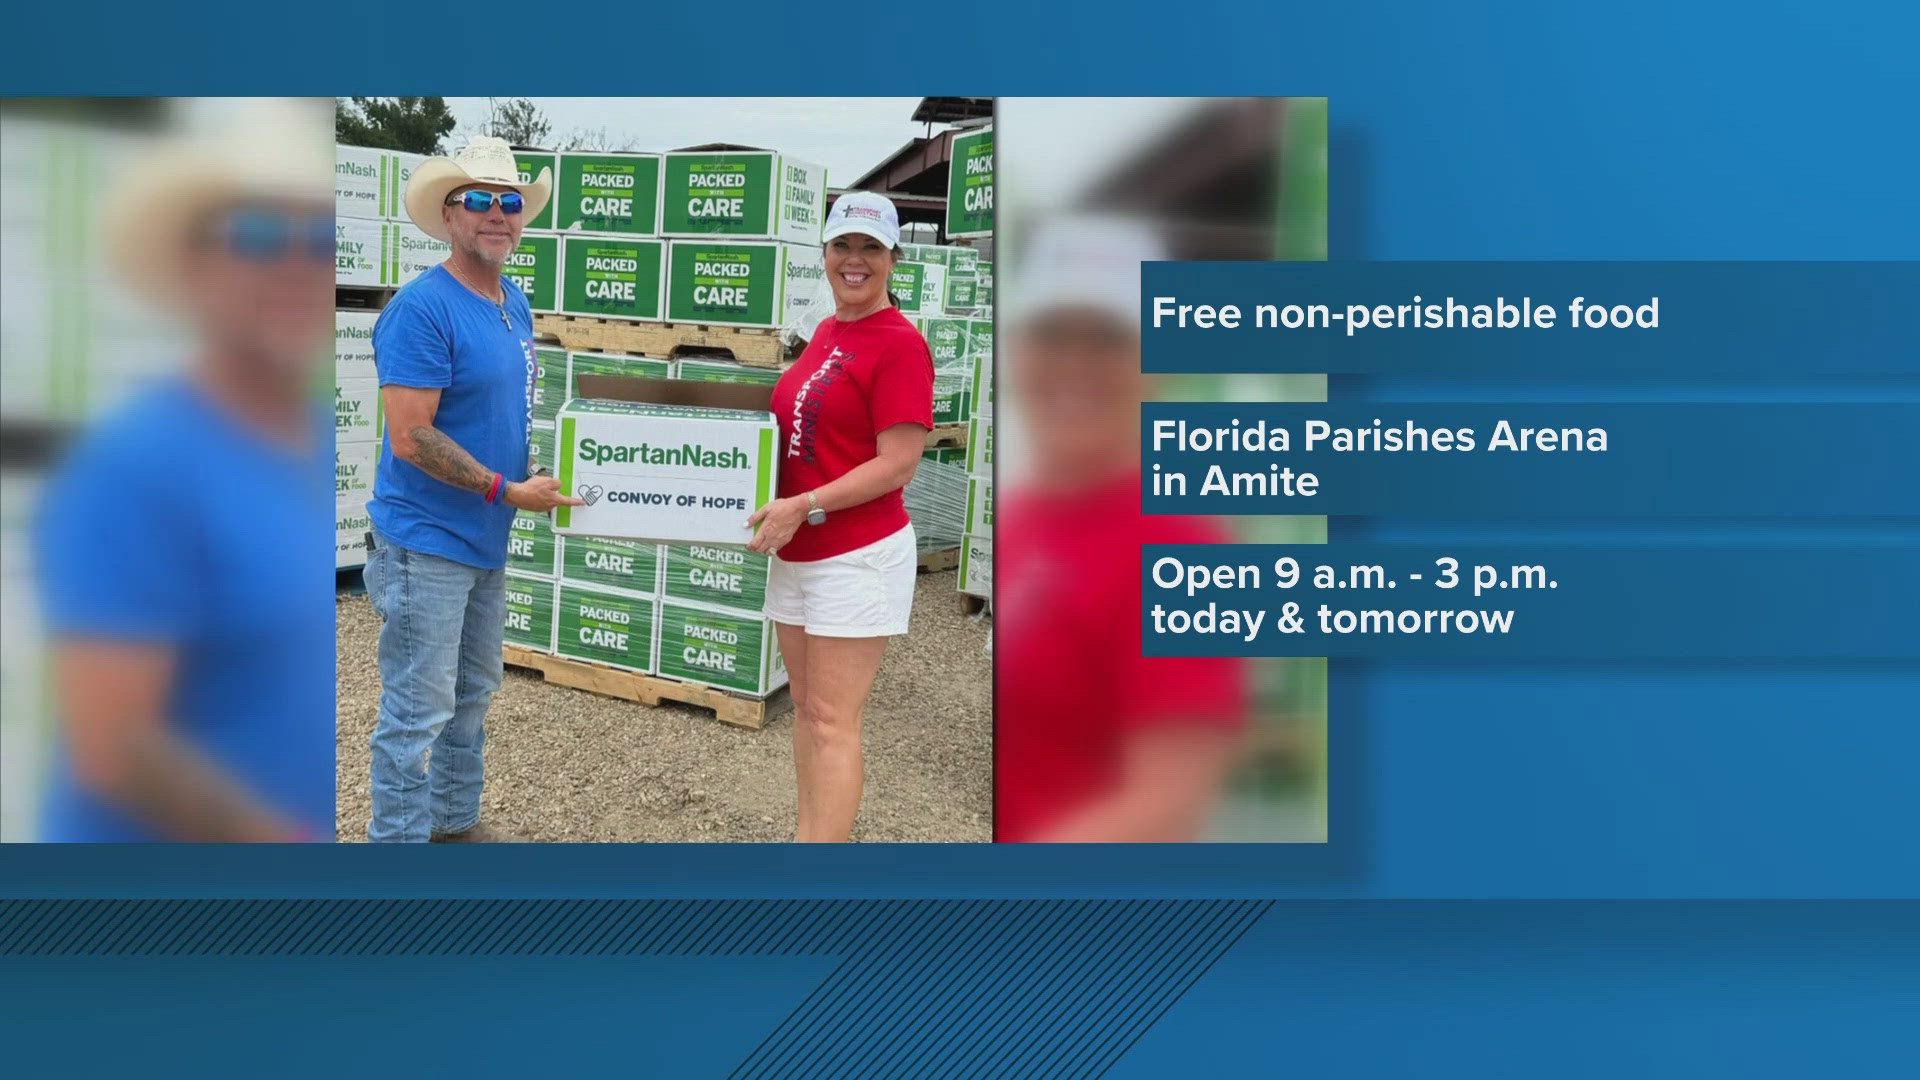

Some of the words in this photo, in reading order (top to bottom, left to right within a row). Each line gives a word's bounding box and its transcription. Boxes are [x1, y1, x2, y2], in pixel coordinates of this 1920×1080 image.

[581, 173, 634, 188] PACKED
[688, 173, 745, 188] PACKED
[794, 167, 807, 185] BOX
[343, 190, 353, 198] OF
[355, 192, 377, 200] HOPE
[792, 186, 815, 206] FAMILY
[964, 186, 993, 212] CAR
[580, 196, 633, 217] CARE
[687, 198, 744, 217] CARE
[792, 206, 810, 223] WEEK
[586, 257, 637, 272] PACKED
[694, 262, 750, 277] PACKED
[585, 280, 636, 300] CARE
[693, 286, 749, 307] CARE
[892, 287, 913, 300] CARE
[344, 353, 353, 361] OF
[935, 346, 957, 358] CARE
[520, 338, 535, 444] TRANSPORT
[787, 346, 843, 458] TRANSPORT
[579, 438, 750, 470] SpartanNash
[607, 491, 673, 506] CONVOY
[676, 494, 697, 507] OF
[702, 496, 746, 510] HOPE
[585, 551, 634, 574] CARE
[690, 546, 744, 565] PACKED
[689, 568, 743, 593] CARE
[580, 605, 630, 625] PACKED
[579, 627, 629, 651] CARE
[684, 624, 738, 645] PACKED
[683, 647, 736, 672] CARE
